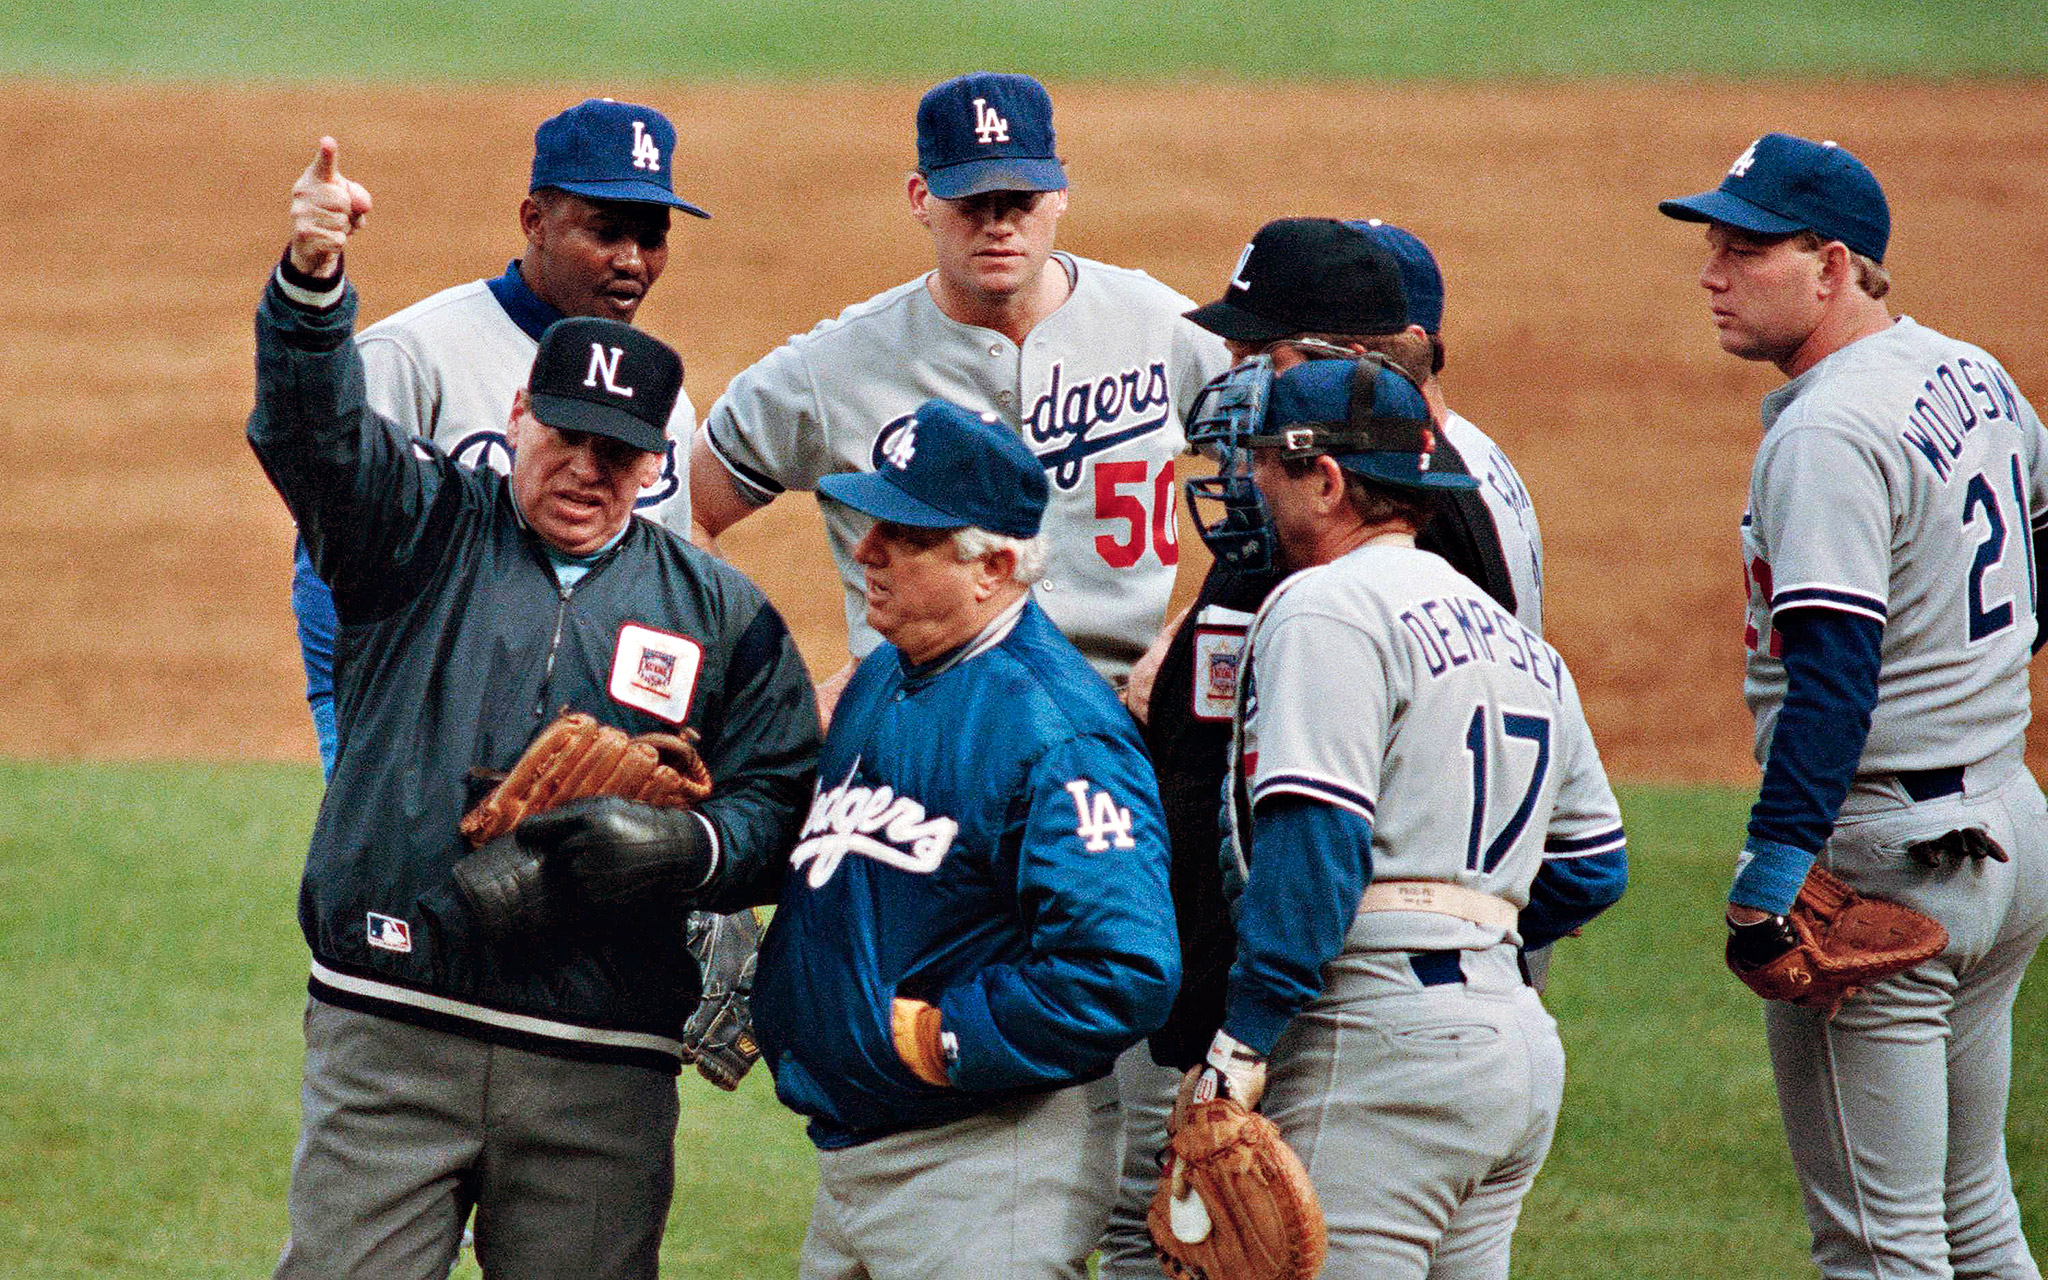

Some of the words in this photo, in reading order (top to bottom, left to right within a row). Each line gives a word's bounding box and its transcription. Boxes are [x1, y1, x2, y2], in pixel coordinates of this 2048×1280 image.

[632, 121, 660, 171] LA
[974, 97, 1010, 144] LA
[583, 342, 633, 398] NL
[1902, 357, 2025, 484] WOODSON
[1094, 460, 1179, 569] 50
[1962, 452, 2037, 644] 21
[1399, 596, 1562, 702] DEMPSEY
[789, 752, 959, 890] dgers
[1065, 779, 1135, 853] LA
[1465, 703, 1552, 875] 17
